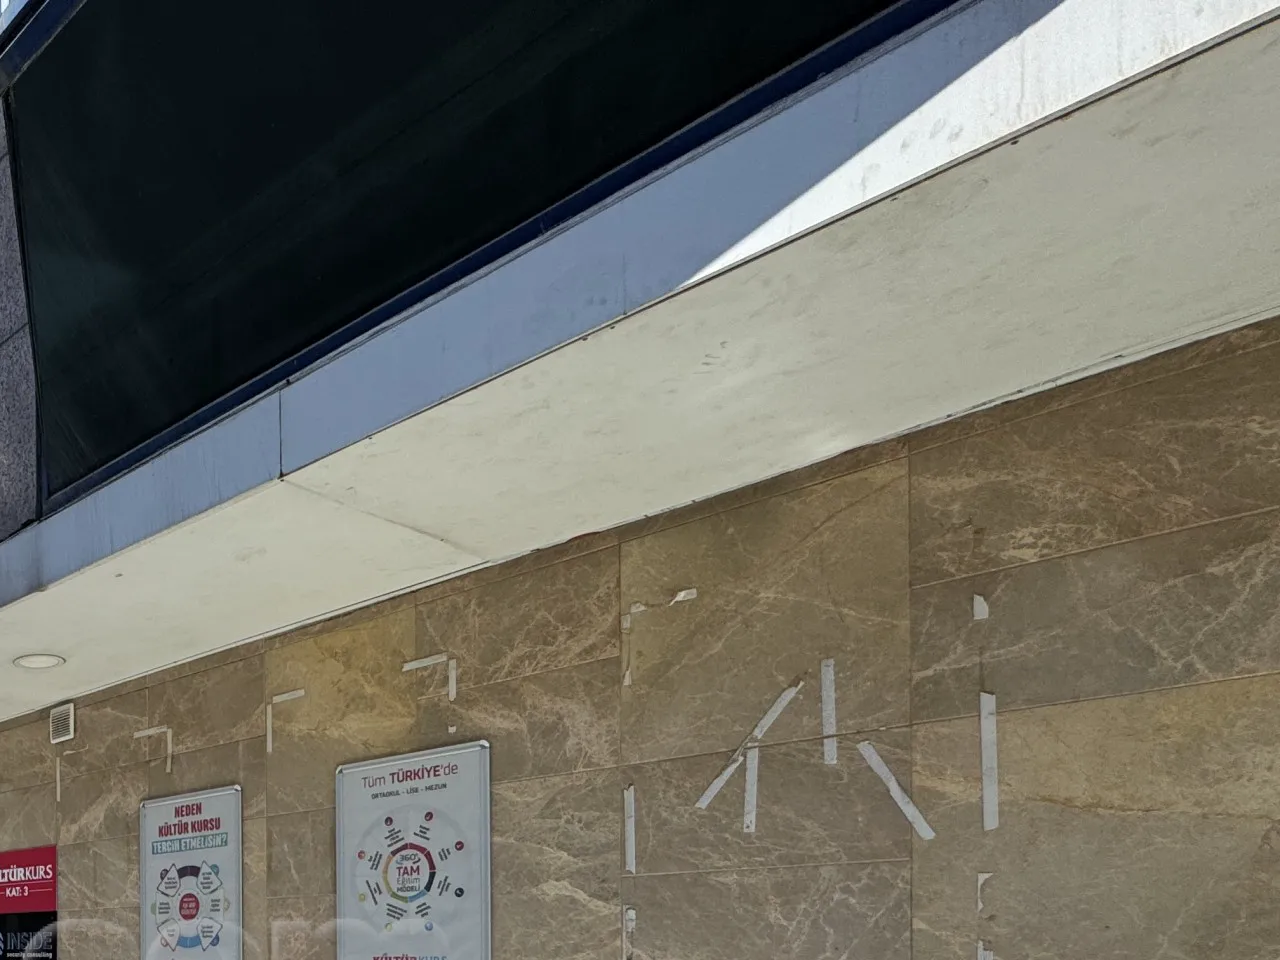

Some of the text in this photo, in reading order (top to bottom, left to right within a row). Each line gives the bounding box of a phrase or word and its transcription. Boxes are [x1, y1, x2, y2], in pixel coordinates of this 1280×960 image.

[361, 762, 459, 789] Tüm TÜRKİYE'de
[371, 790, 401, 800] ORTAOKUL
[425, 782, 447, 792] MEZUN
[174, 802, 202, 818] NEDEN
[158, 817, 221, 838] KÜLTÜR KURSU
[396, 865, 421, 877] TAM
[5, 885, 29, 897] KAT: 3
[6, 931, 53, 950] INSIDE
